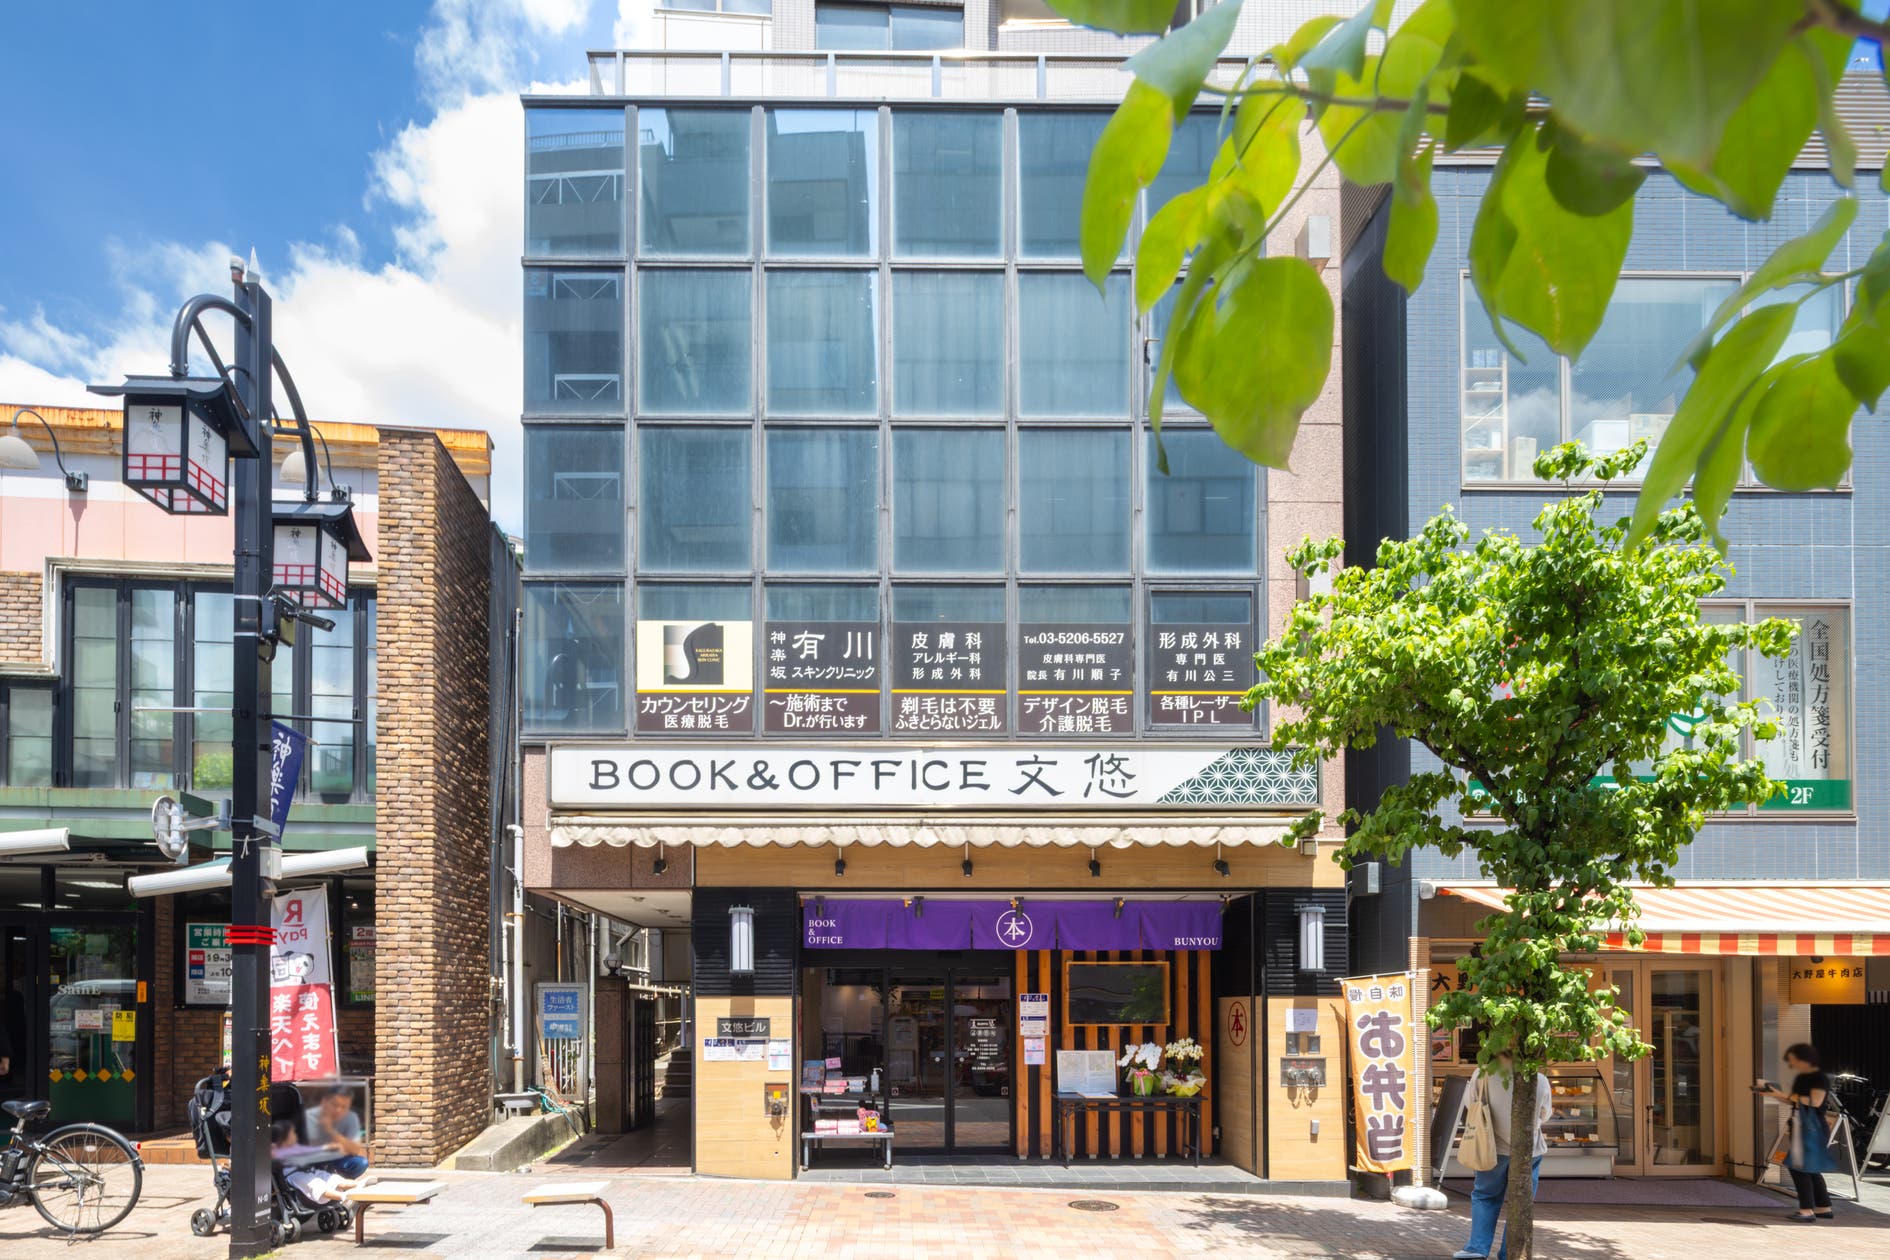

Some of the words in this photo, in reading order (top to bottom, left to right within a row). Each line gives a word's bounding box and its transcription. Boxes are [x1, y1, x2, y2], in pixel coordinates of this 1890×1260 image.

[791, 630, 872, 660] 有川
[911, 631, 982, 649] 皮膚科
[1159, 631, 1241, 649] 形成外科
[770, 631, 787, 679] 神楽坂
[912, 651, 981, 664] アレルギー科
[1042, 653, 1106, 664] 皮膚科専門医
[1175, 653, 1225, 665] 専門医
[791, 665, 875, 679] スキンクリニック
[912, 667, 981, 680] 形成外科
[1026, 670, 1047, 680] 院長
[1054, 668, 1122, 681] 有川順子
[1166, 669, 1235, 682] 有川公三
[1809, 619, 1830, 769] 全国処方箋受付
[640, 696, 750, 714] カウンセリング
[901, 696, 996, 715] 剃毛は不要
[1023, 697, 1128, 715] デザイン脱毛
[1160, 695, 1242, 710] 各種レーザー
[664, 714, 729, 729] 医療脱毛
[783, 712, 868, 729] Dr.が行います
[895, 714, 1002, 730] ふきとらないジェル
[1039, 714, 1112, 732] 介護脱毛
[589, 759, 990, 791] BOOK&OFFICE
[1008, 752, 1138, 798] 文悠
[1790, 787, 1814, 804] 2F
[808, 919, 836, 928] BOOK
[1003, 917, 1026, 940] 本
[808, 928, 816, 936] &
[808, 936, 844, 944] OFFICE
[1174, 937, 1219, 946] BUNYOU
[1792, 967, 1863, 980] 大野屋牛肉店
[721, 1022, 766, 1033] 文悠ビル
[1230, 1008, 1244, 1037] 本
